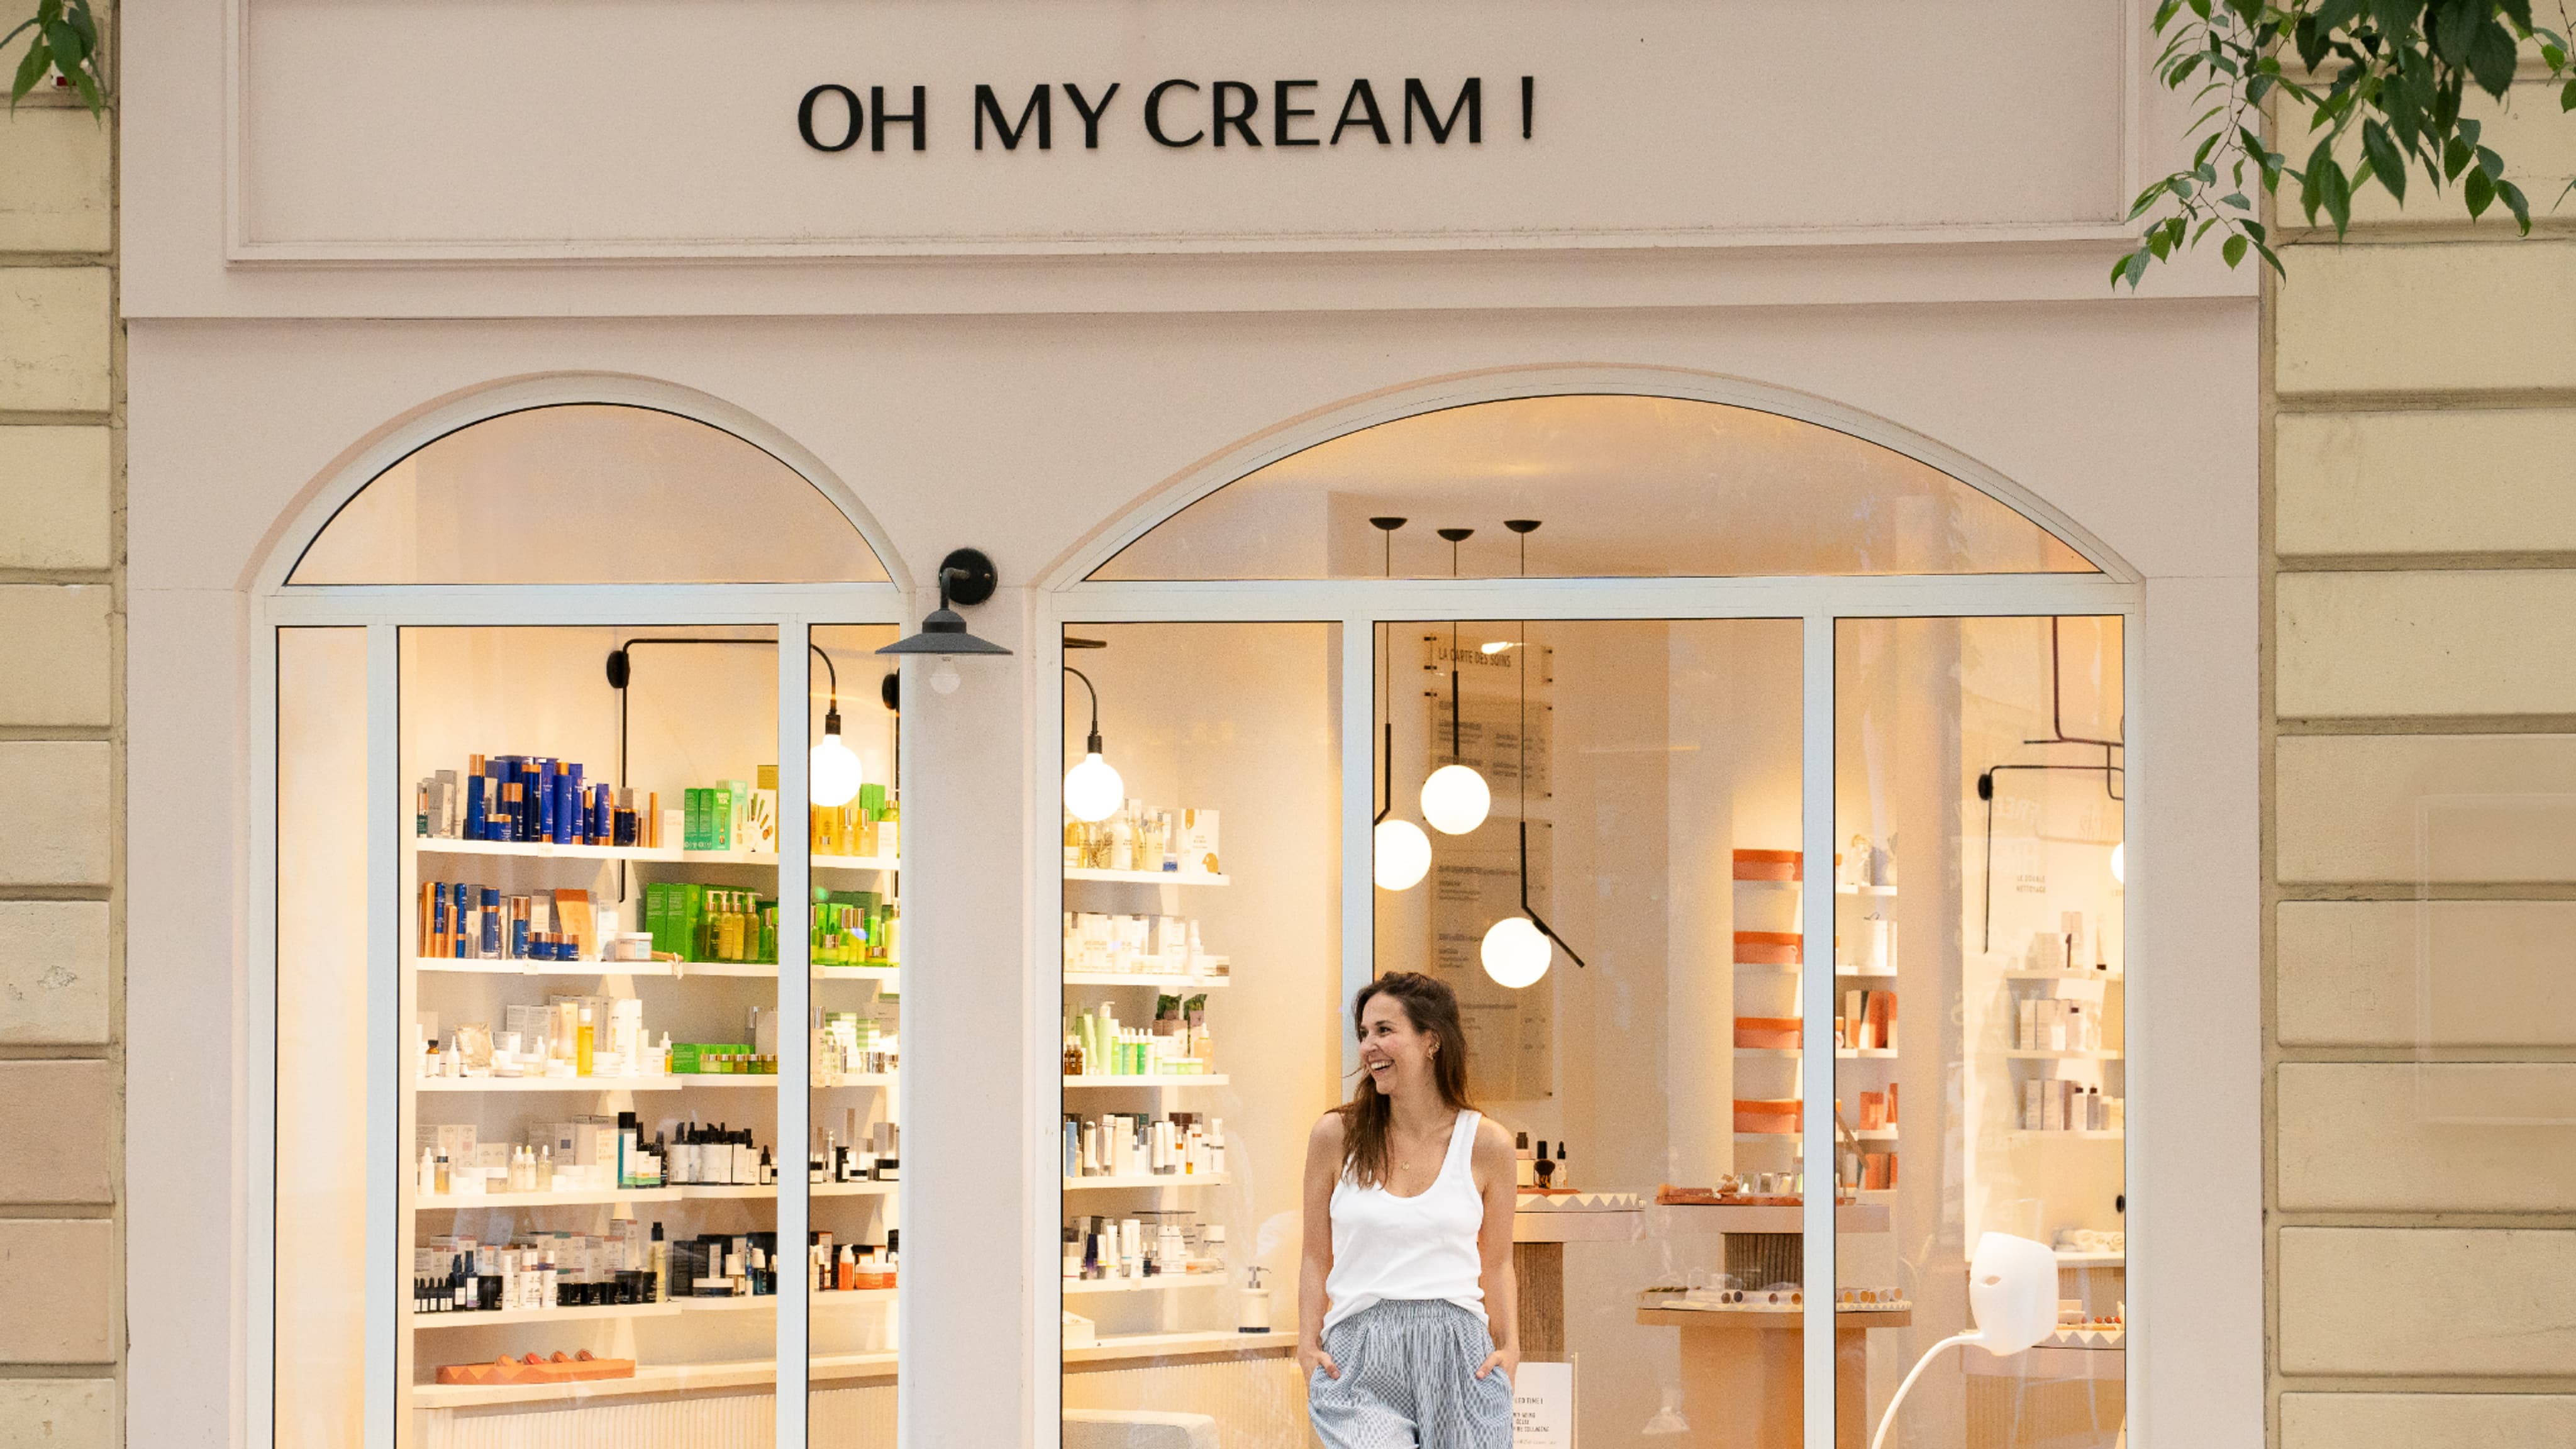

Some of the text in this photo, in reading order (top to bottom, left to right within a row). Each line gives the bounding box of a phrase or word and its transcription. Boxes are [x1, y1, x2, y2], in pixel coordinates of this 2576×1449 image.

[797, 75, 1535, 155] OH MY CREAM !
[1438, 647, 1511, 667] LA CARTE DES SOINS
